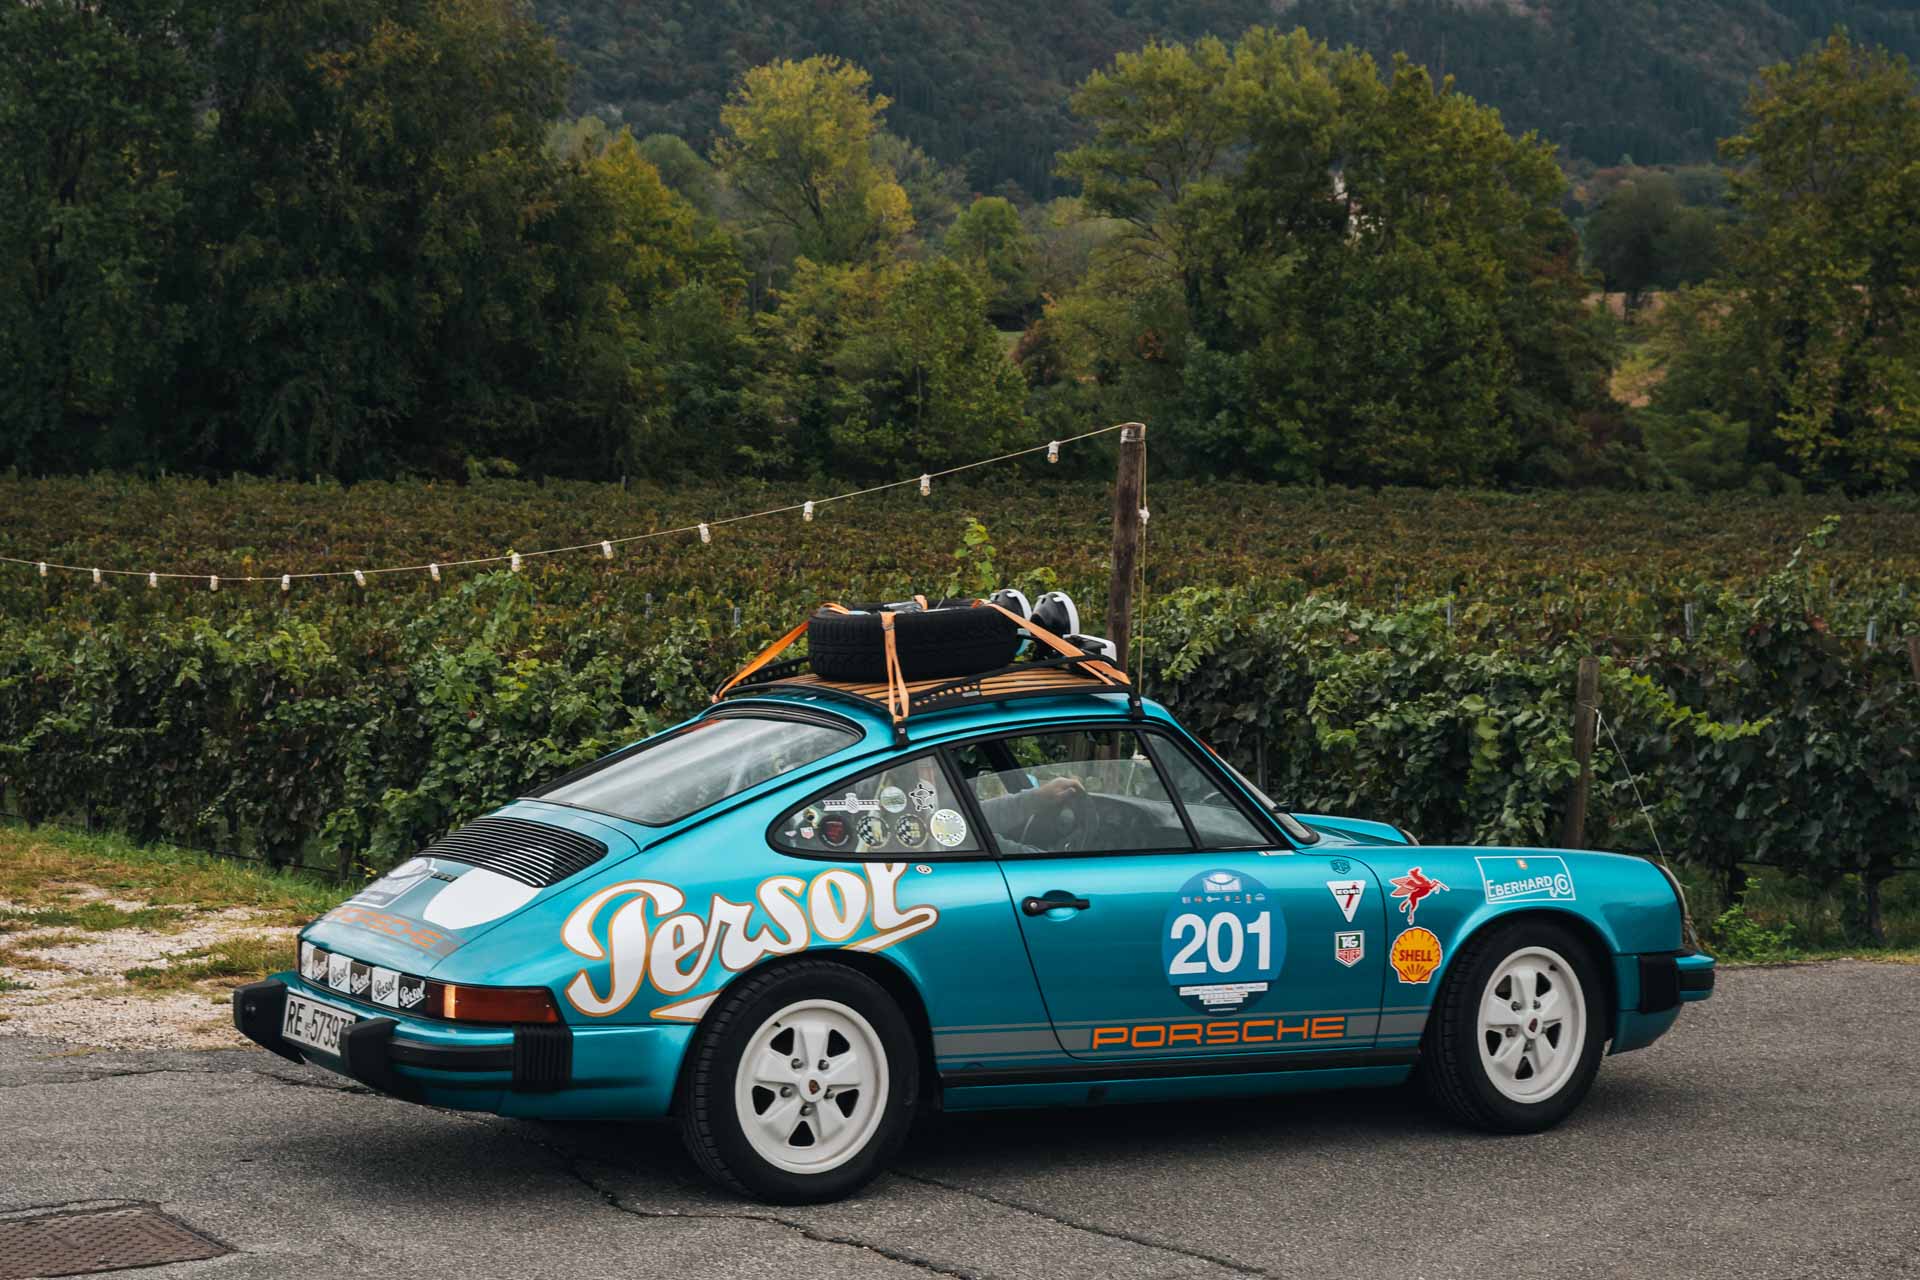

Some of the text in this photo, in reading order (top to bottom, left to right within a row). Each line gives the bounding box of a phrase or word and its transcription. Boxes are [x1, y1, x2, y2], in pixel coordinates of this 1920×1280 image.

[1486, 876, 1553, 897] EBERHARD
[560, 862, 940, 1021] Persol
[1168, 911, 1271, 975] 201
[1340, 936, 1359, 948] TAG
[1399, 950, 1433, 962] SHELL
[400, 981, 425, 1008] Persol
[285, 1001, 353, 1048] RE 5739
[1092, 1016, 1345, 1050] PORSCHE
